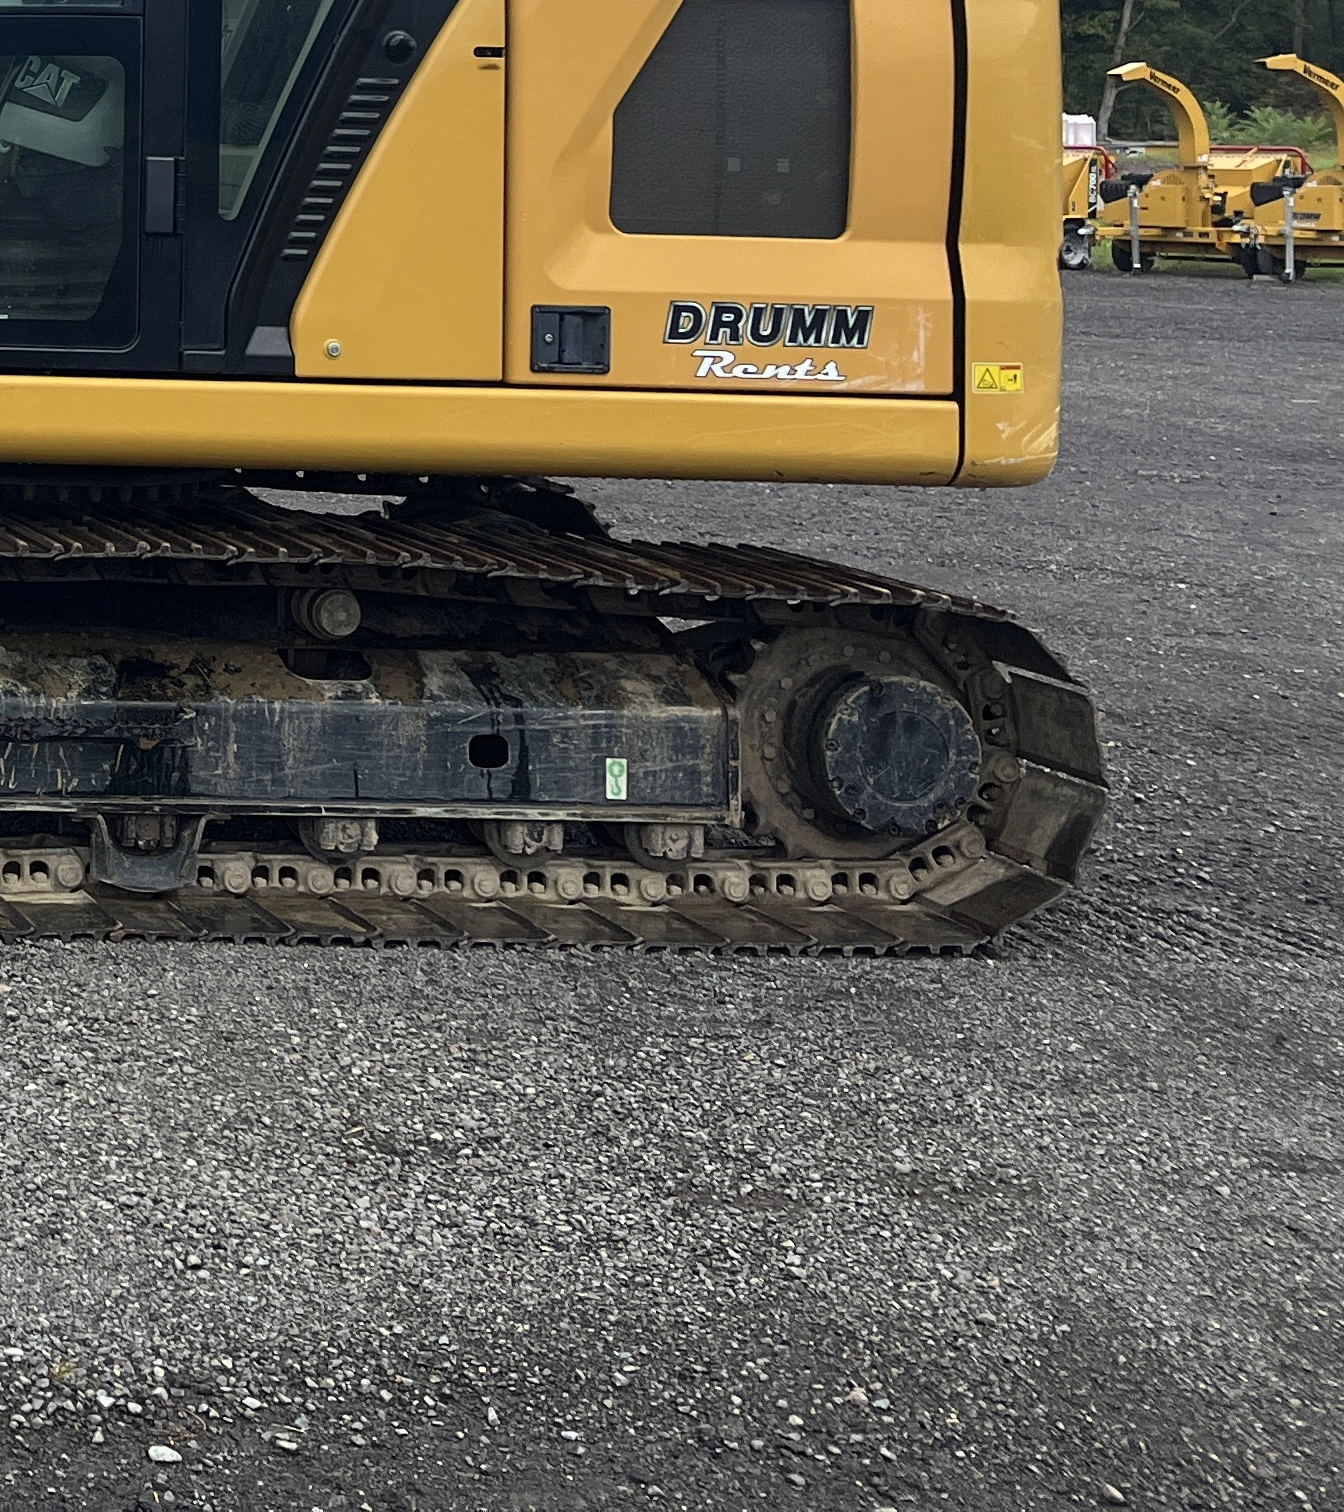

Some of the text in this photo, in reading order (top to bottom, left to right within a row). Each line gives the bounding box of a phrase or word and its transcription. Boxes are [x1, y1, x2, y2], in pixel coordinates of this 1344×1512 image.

[15, 56, 81, 108] CAT
[1149, 70, 1181, 94] Vermeer
[1303, 64, 1340, 91] Vermeer
[663, 300, 875, 349] DRUMM
[691, 349, 847, 381] Rents
